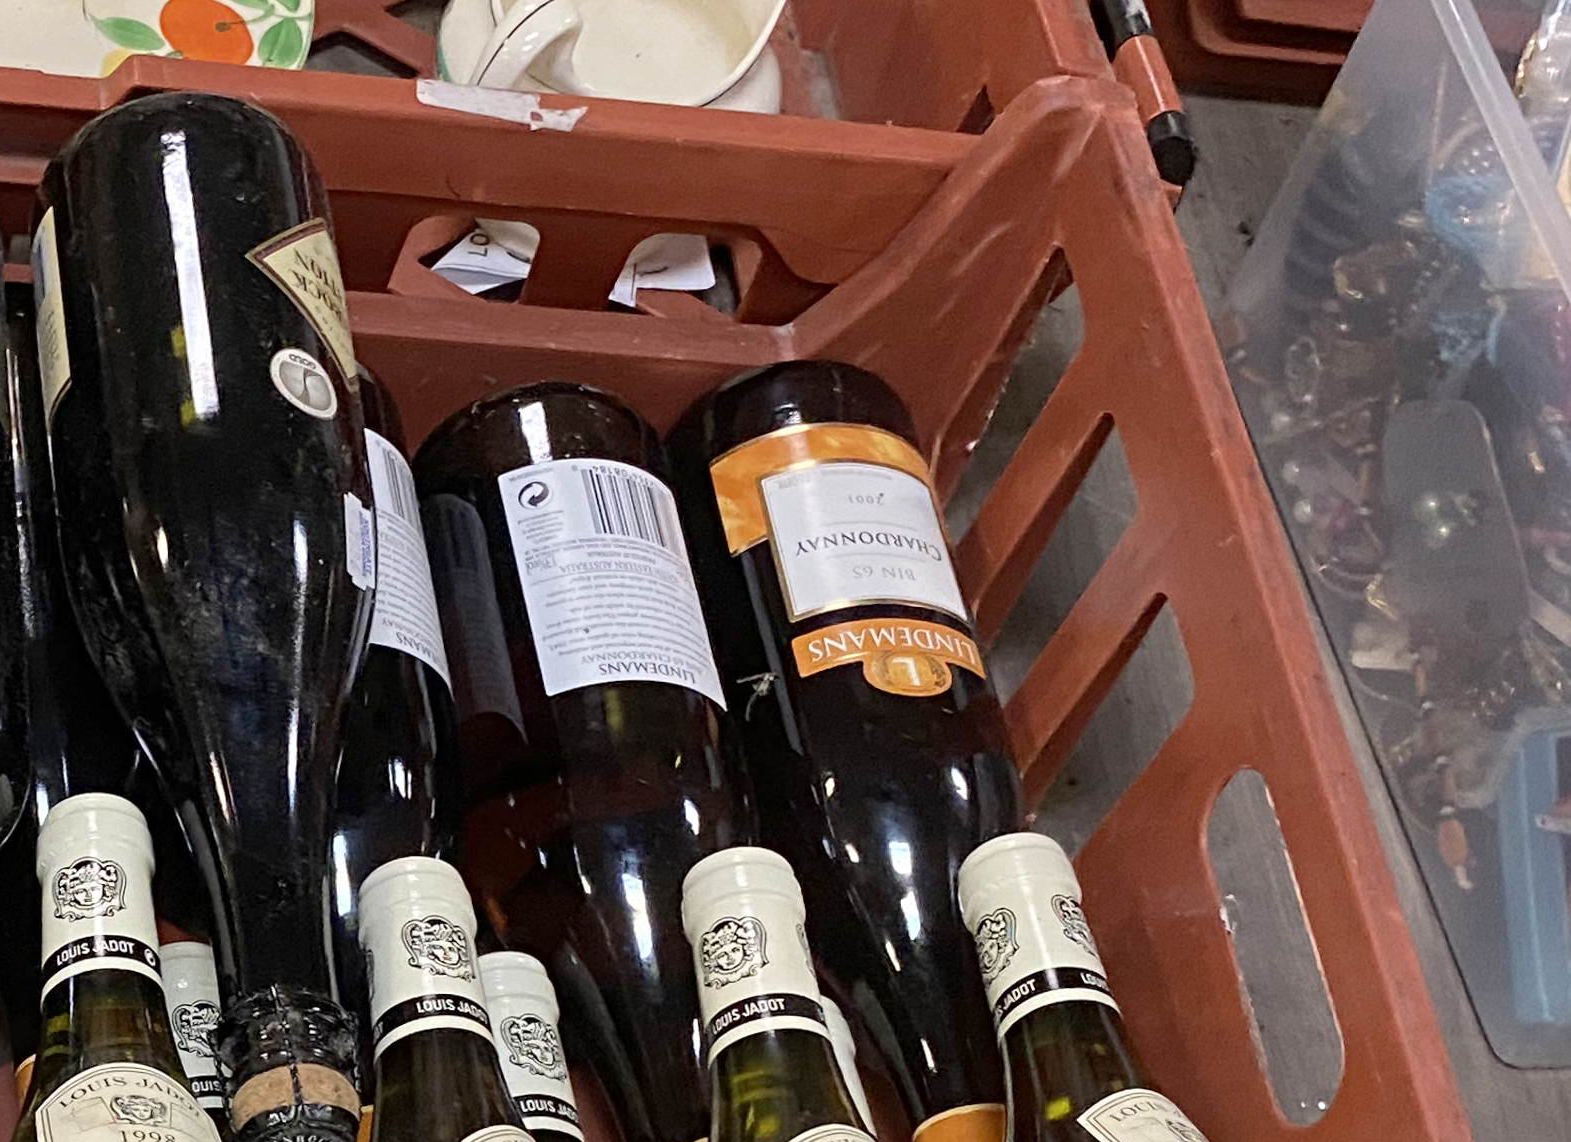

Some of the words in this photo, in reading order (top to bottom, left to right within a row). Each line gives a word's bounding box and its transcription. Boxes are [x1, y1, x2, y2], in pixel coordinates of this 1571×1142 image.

[848, 493, 885, 506] 2001
[795, 531, 942, 561] CHARDONNAY
[852, 566, 873, 579] 65
[882, 567, 915, 582] BIN
[808, 626, 976, 665] LINDEMANS
[581, 651, 672, 665] CHARDONNAY
[598, 661, 696, 684] LINDEMANS
[892, 656, 921, 687] L
[56, 942, 90, 966] LOUIS
[92, 941, 135, 957] JADOT
[1003, 978, 1036, 1006] JADOT
[416, 997, 456, 1014] LOUIS
[712, 1008, 740, 1034] LOUIS
[742, 997, 786, 1020] JADOT
[59, 1075, 127, 1108] LOUIS
[135, 1078, 202, 1118] JADOT
[191, 1080, 221, 1093] OUIS
[520, 1099, 556, 1114] LOUIS
